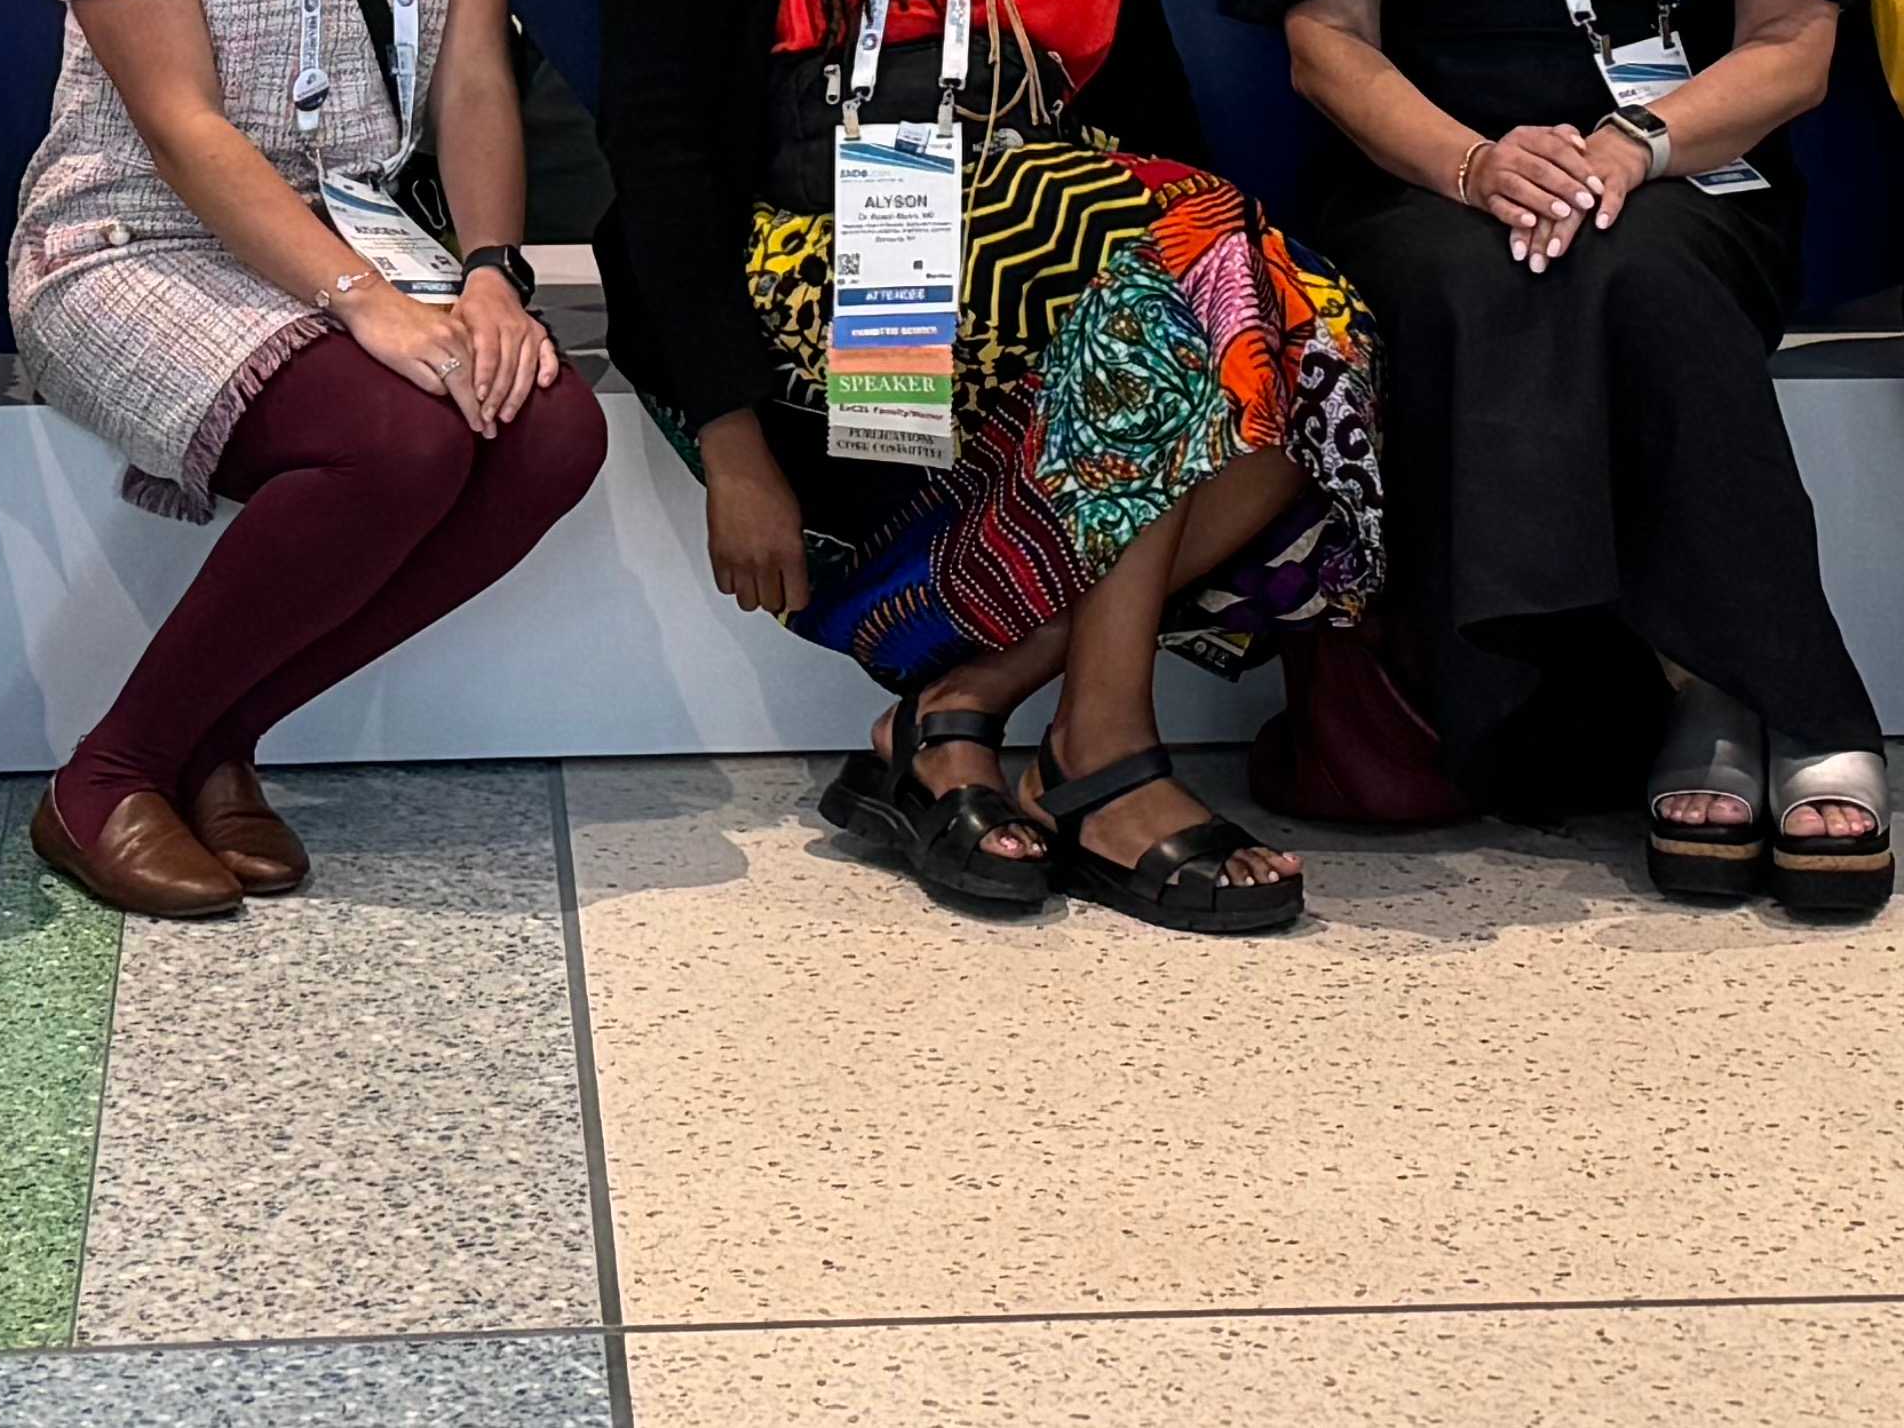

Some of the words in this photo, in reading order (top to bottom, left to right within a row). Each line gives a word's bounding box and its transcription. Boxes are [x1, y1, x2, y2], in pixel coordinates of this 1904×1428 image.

[864, 194, 928, 209] ALYSON
[865, 287, 926, 301] ATTENDEE
[839, 375, 937, 393] SPEAKER
